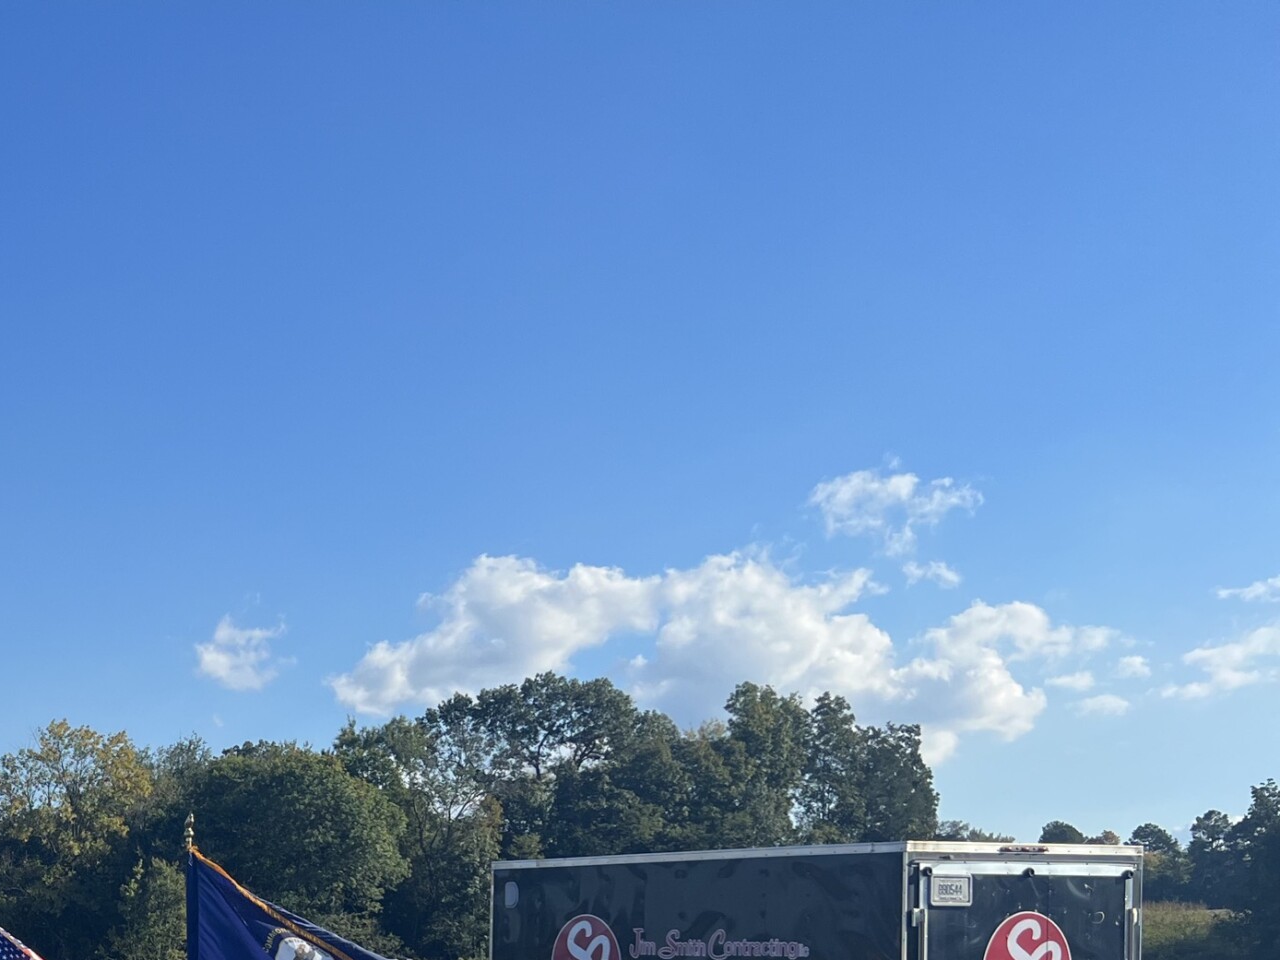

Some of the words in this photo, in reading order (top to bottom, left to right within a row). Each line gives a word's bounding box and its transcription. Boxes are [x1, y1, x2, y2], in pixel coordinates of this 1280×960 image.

[629, 928, 656, 958] Jim
[657, 929, 706, 960] Smith
[708, 928, 800, 960] Contracting
